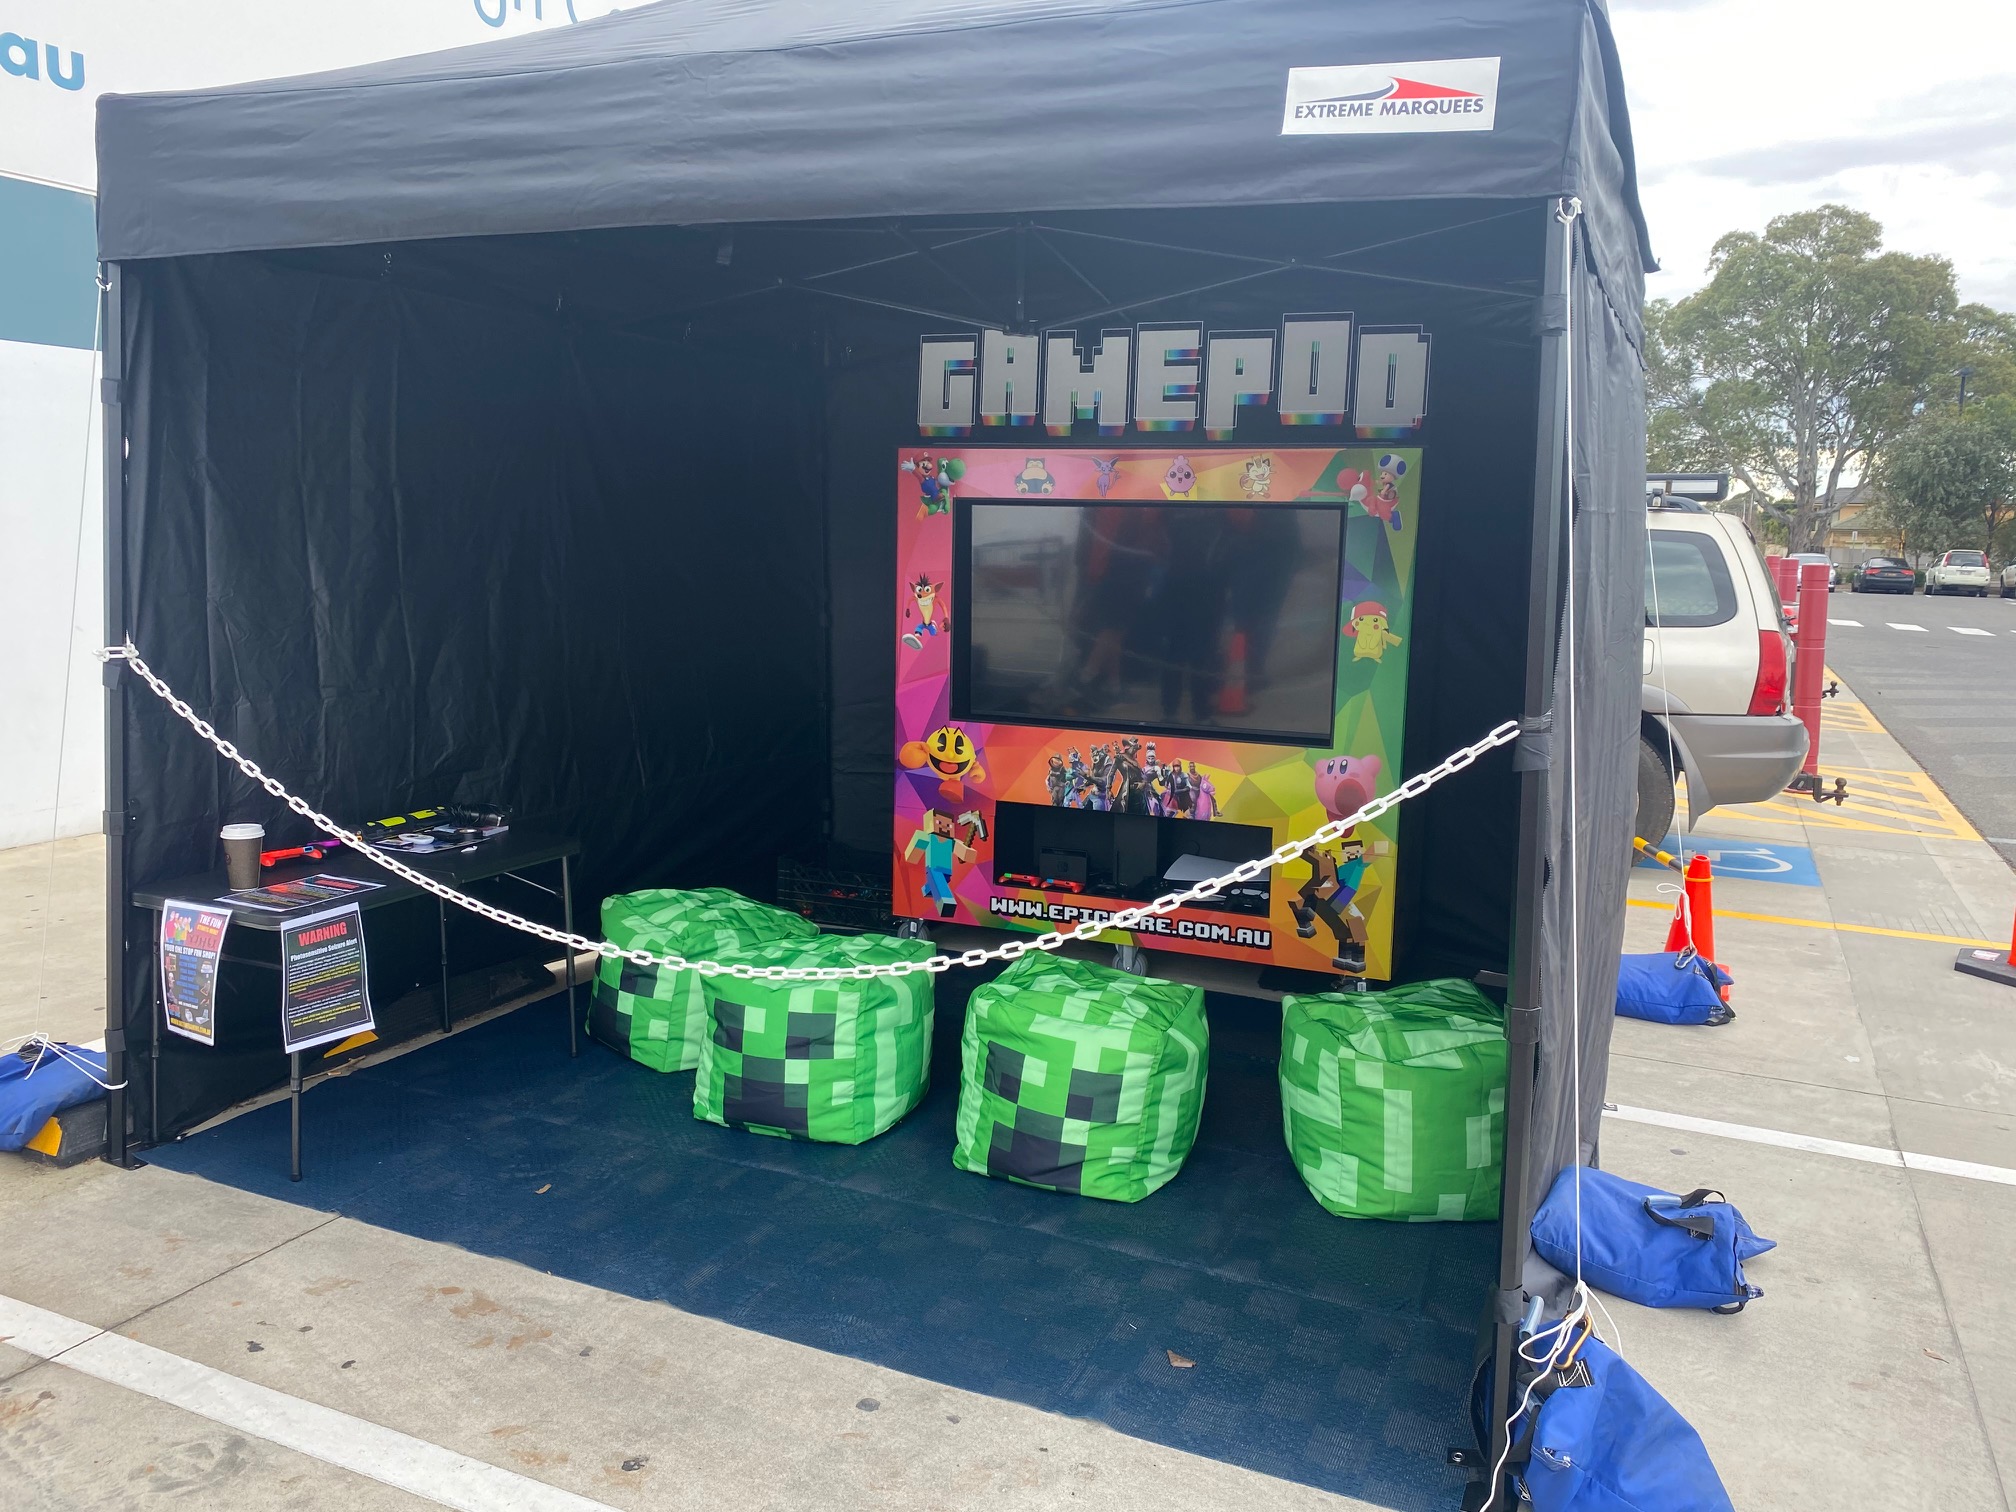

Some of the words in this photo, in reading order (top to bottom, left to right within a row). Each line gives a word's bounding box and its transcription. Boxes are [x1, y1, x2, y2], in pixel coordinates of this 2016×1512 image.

[1294, 102, 1374, 119] EXTREME
[1379, 98, 1484, 116] MARQUEES
[917, 311, 1432, 441] GAMEPOD
[200, 914, 211, 925] THE
[298, 921, 347, 946] WARNING
[183, 947, 193, 955] STOP
